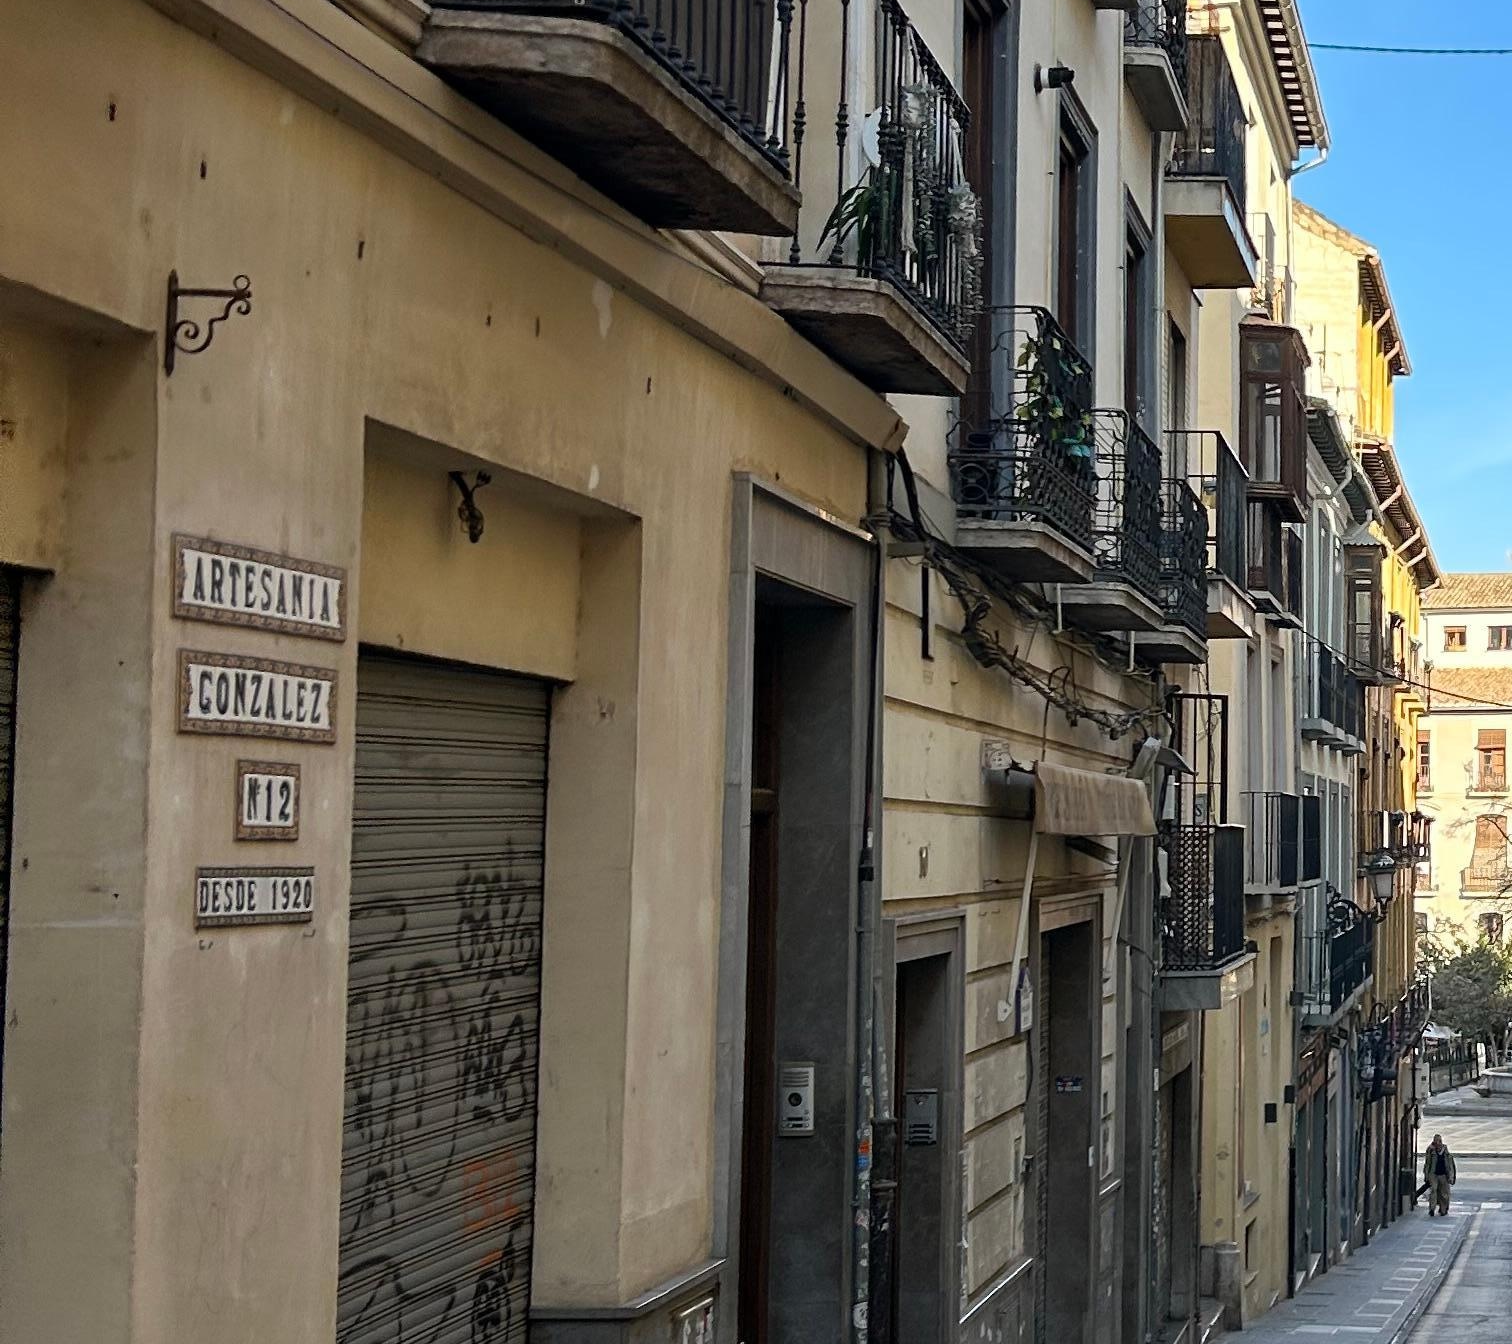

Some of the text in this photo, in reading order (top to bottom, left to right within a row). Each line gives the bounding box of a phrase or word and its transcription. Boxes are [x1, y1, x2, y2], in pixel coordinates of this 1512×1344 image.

[192, 554, 332, 624] ARTESANIA
[198, 669, 323, 725] GONZALEZ
[199, 877, 313, 914] DESDE 1920
